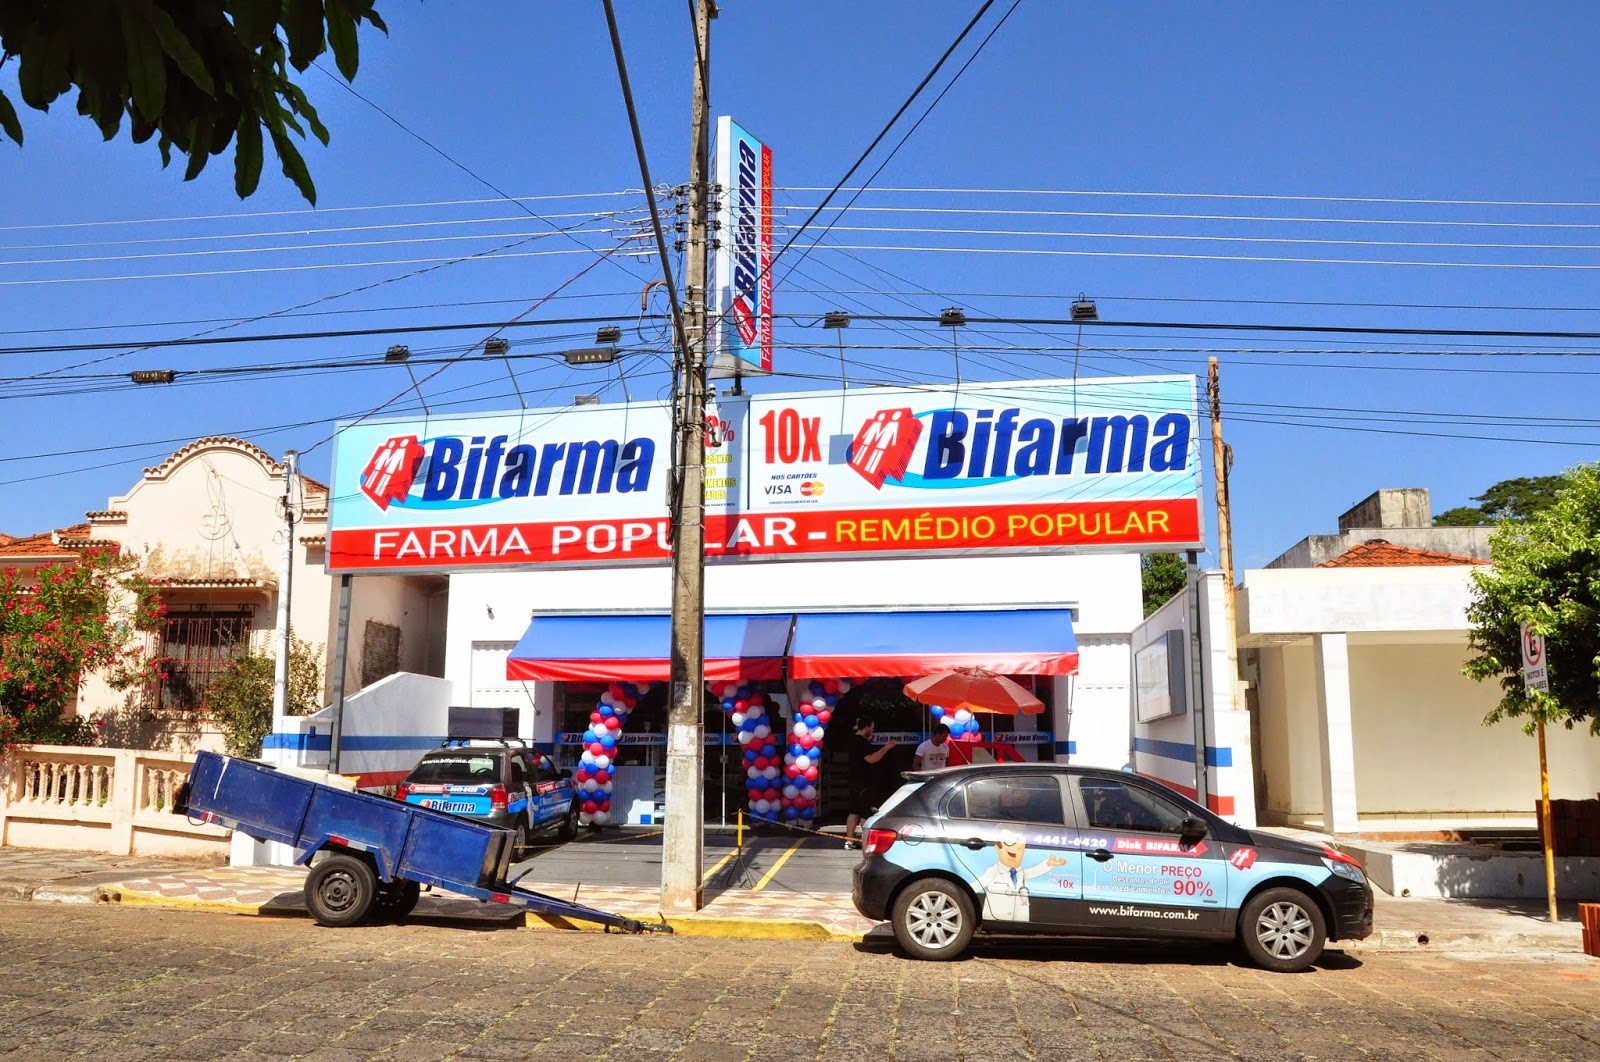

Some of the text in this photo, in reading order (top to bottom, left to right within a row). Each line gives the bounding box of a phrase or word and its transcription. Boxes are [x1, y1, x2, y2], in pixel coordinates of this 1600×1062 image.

[734, 139, 756, 304] Bifarma
[759, 407, 822, 465] 10x
[922, 408, 1191, 481] Bifarma
[705, 454, 733, 465] SCONTO
[422, 436, 655, 502] Bifarma
[786, 472, 818, 480] CARTÕES
[764, 484, 792, 495] VISA
[373, 527, 531, 560] FARMA
[552, 516, 797, 554] POPAR
[835, 512, 995, 544] REMÉDIO
[1008, 510, 1170, 539] POPULAR
[1004, 734, 1017, 742] Seja
[431, 800, 476, 812] Bifarma
[1033, 834, 1108, 848] 4441-6420
[1117, 840, 1198, 853] Disk BIFARMA
[1117, 860, 1158, 875] Menor
[1161, 865, 1203, 880] PREÇO
[1057, 879, 1074, 889] 10x
[1112, 875, 1148, 885] Descontos
[1149, 877, 1159, 885] de
[1111, 885, 1170, 895] medicamentos
[1173, 879, 1214, 898] 90%
[1089, 905, 1200, 921] www.bifarma.com.br
